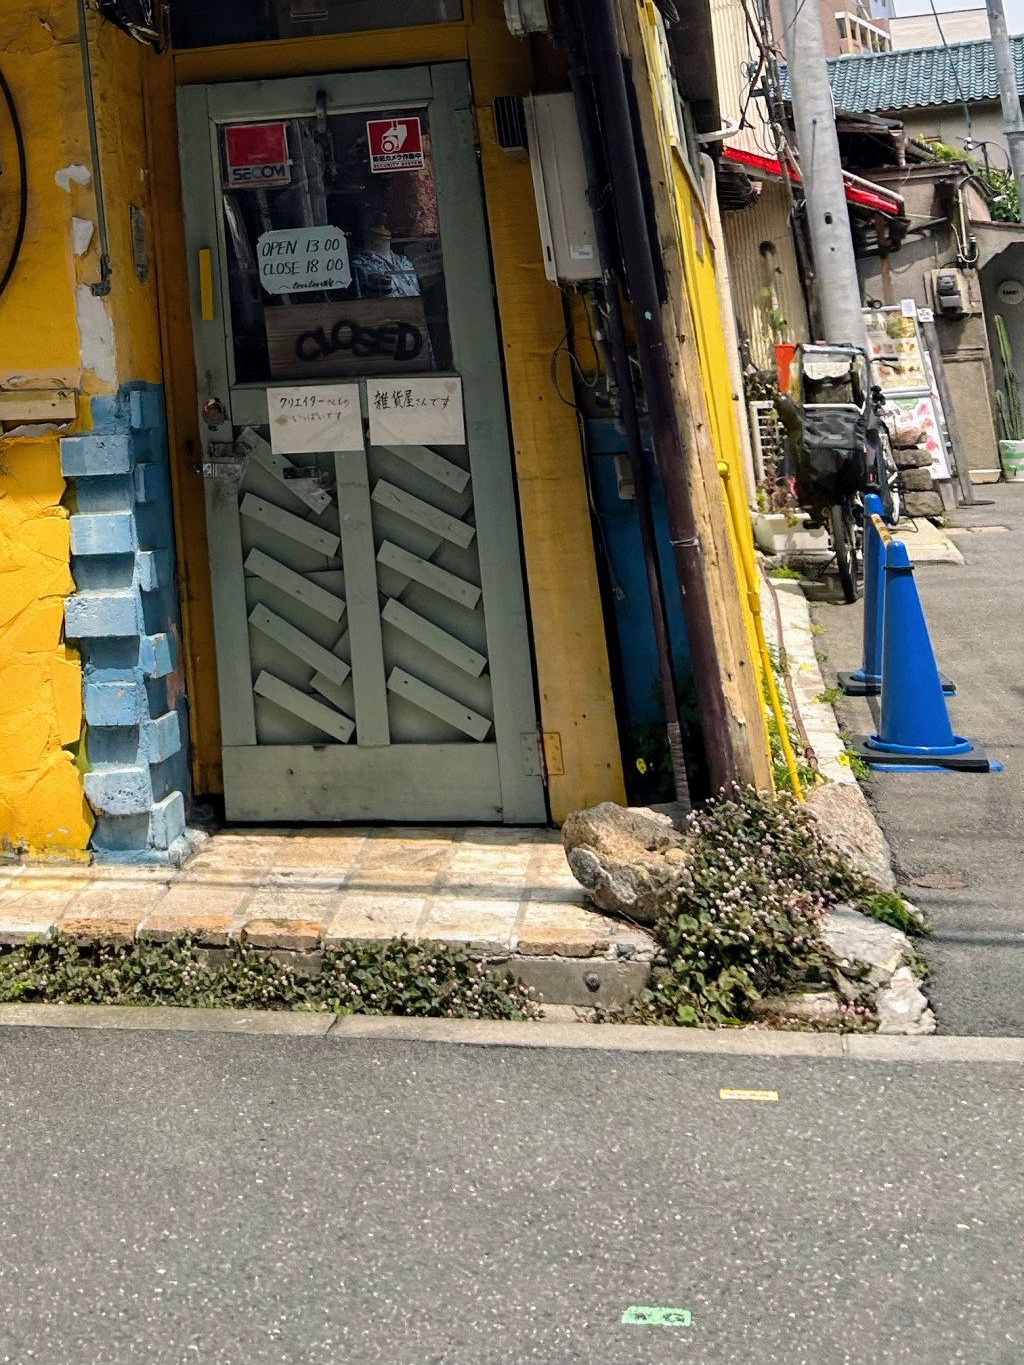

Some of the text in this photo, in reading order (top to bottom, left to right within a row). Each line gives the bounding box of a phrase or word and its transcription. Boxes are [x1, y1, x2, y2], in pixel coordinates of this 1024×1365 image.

[233, 165, 285, 181] SECOM
[262, 239, 298, 257] OPEN
[263, 258, 344, 276] CLOSE 18 00
[296, 319, 423, 361] CLOSED
[373, 389, 451, 411] 雑貨屋さんです
